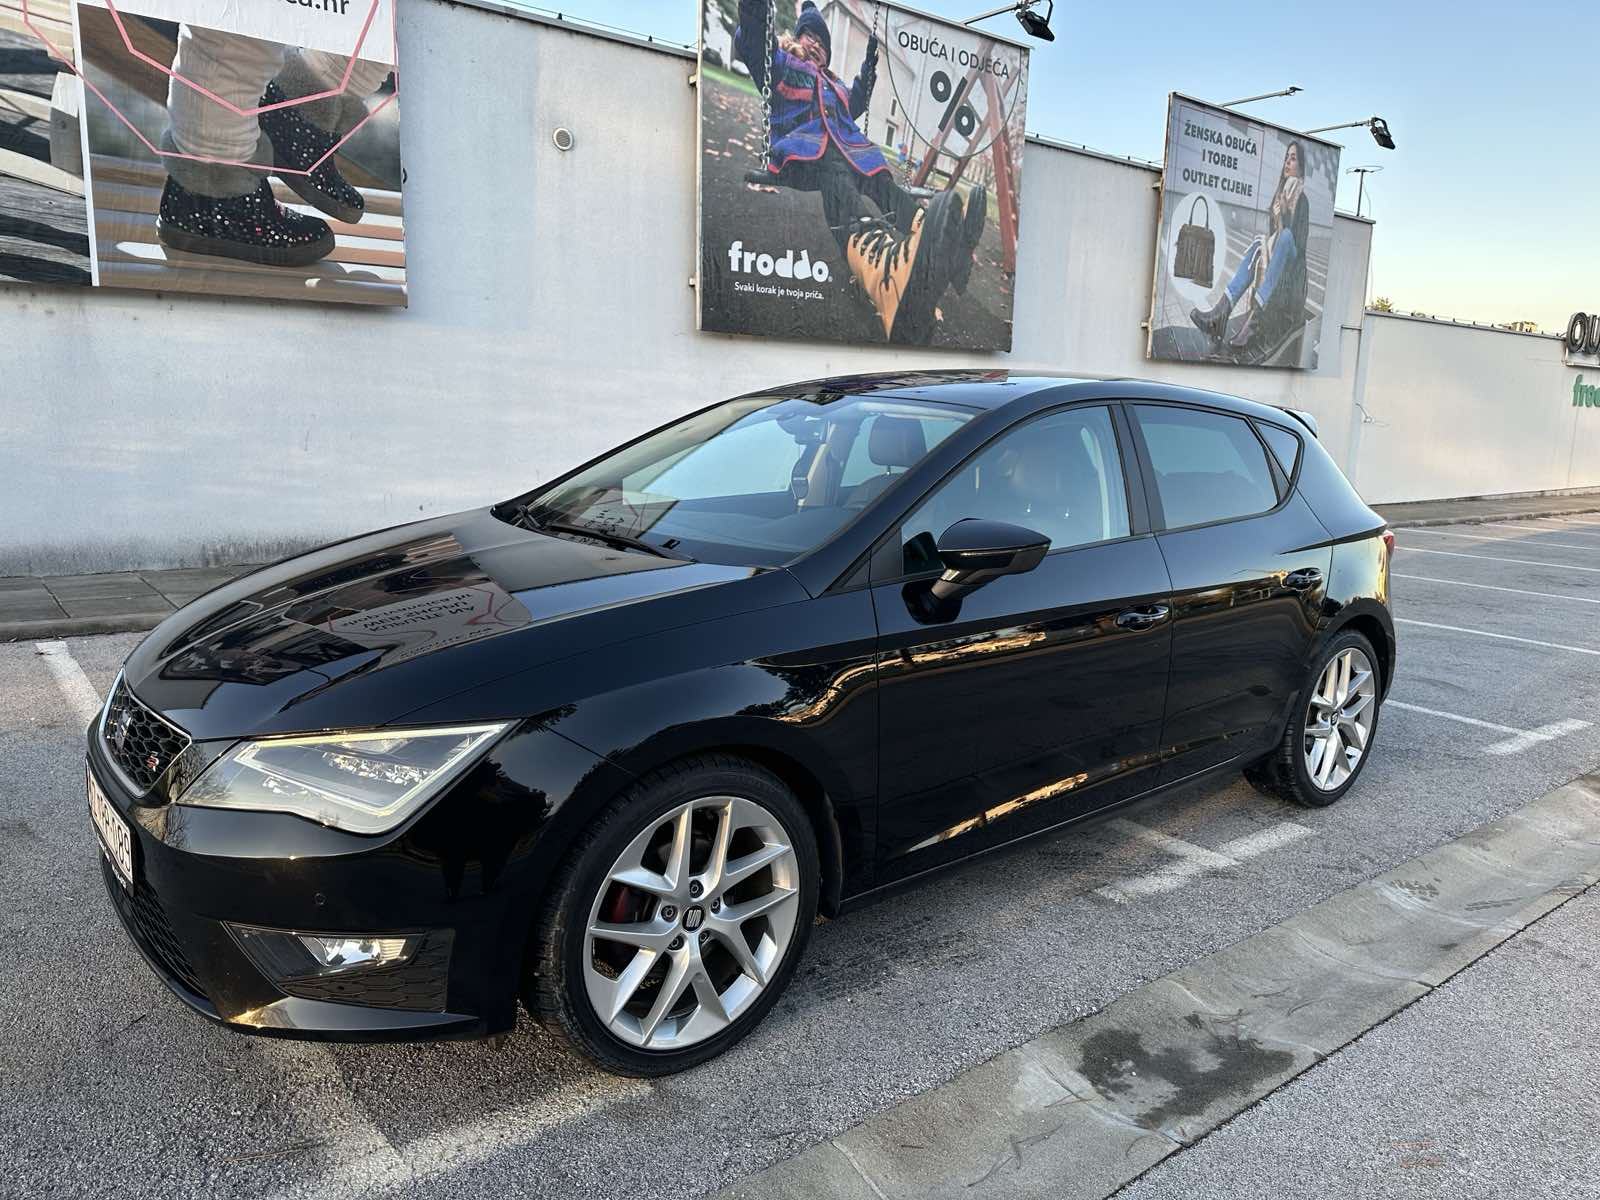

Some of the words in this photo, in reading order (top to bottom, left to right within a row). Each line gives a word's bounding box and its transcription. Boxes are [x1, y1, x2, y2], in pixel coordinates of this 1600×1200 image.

[898, 31, 947, 61] OBUĆA
[951, 47, 955, 62] I
[958, 50, 1009, 79] ODJEĆA
[1184, 120, 1223, 145] ŽENSKA
[1225, 135, 1257, 156] OBUĆA
[1202, 149, 1206, 161] I
[1208, 151, 1238, 170] TORBE
[1183, 168, 1219, 188] OUTLET
[1221, 178, 1252, 196] CIJENE
[728, 241, 829, 282] froddo
[734, 281, 754, 292] Svaki
[756, 284, 776, 294] korak
[778, 286, 785, 297] je
[786, 288, 804, 299] tvoja
